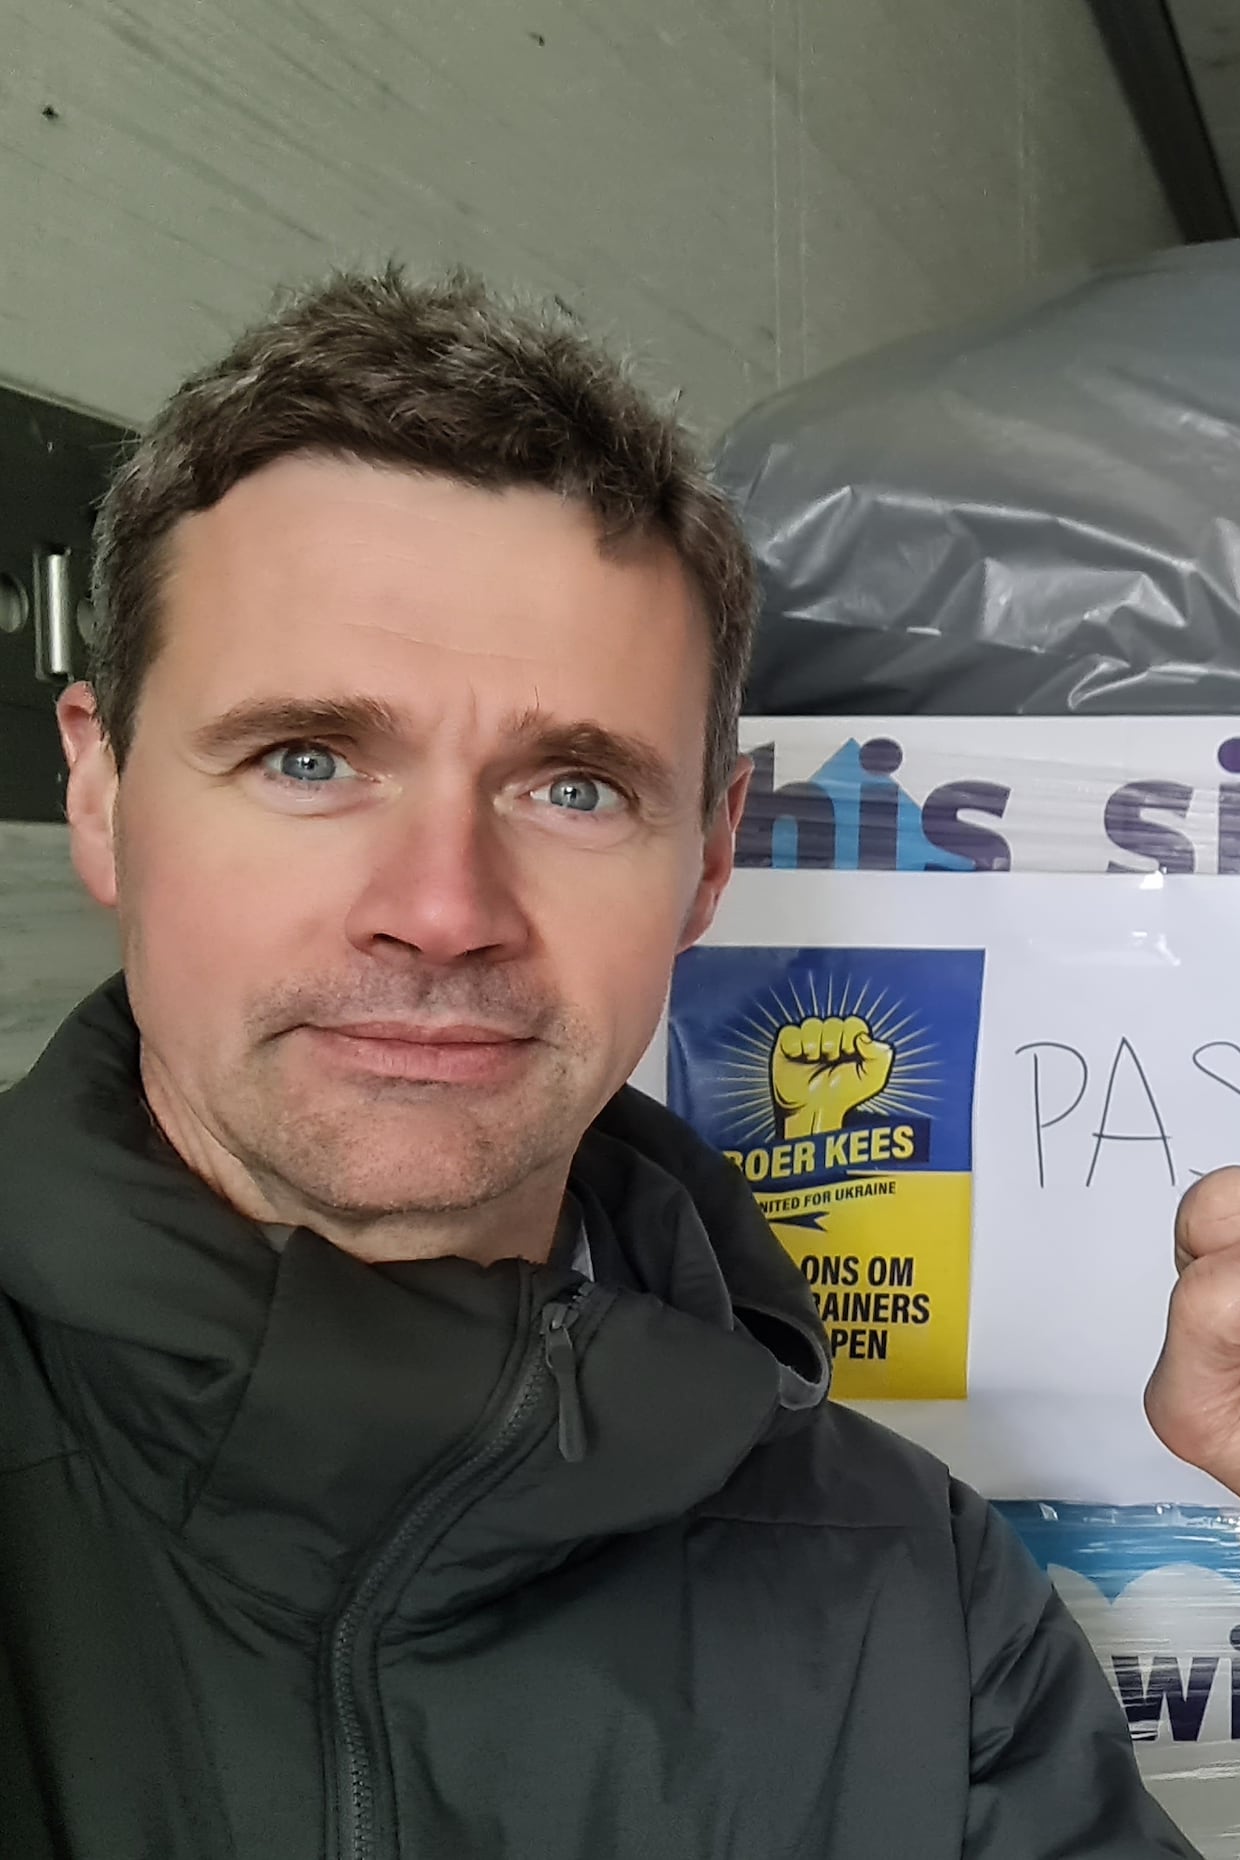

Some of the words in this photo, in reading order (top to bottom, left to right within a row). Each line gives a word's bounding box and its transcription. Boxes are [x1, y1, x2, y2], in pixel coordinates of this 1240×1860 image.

[825, 1126, 915, 1168] KEES
[758, 1196, 800, 1214] NITED
[803, 1190, 832, 1209] FOR
[835, 1181, 897, 1202] UKRAINE
[801, 1255, 860, 1286] ONS
[867, 1256, 915, 1287] OM
